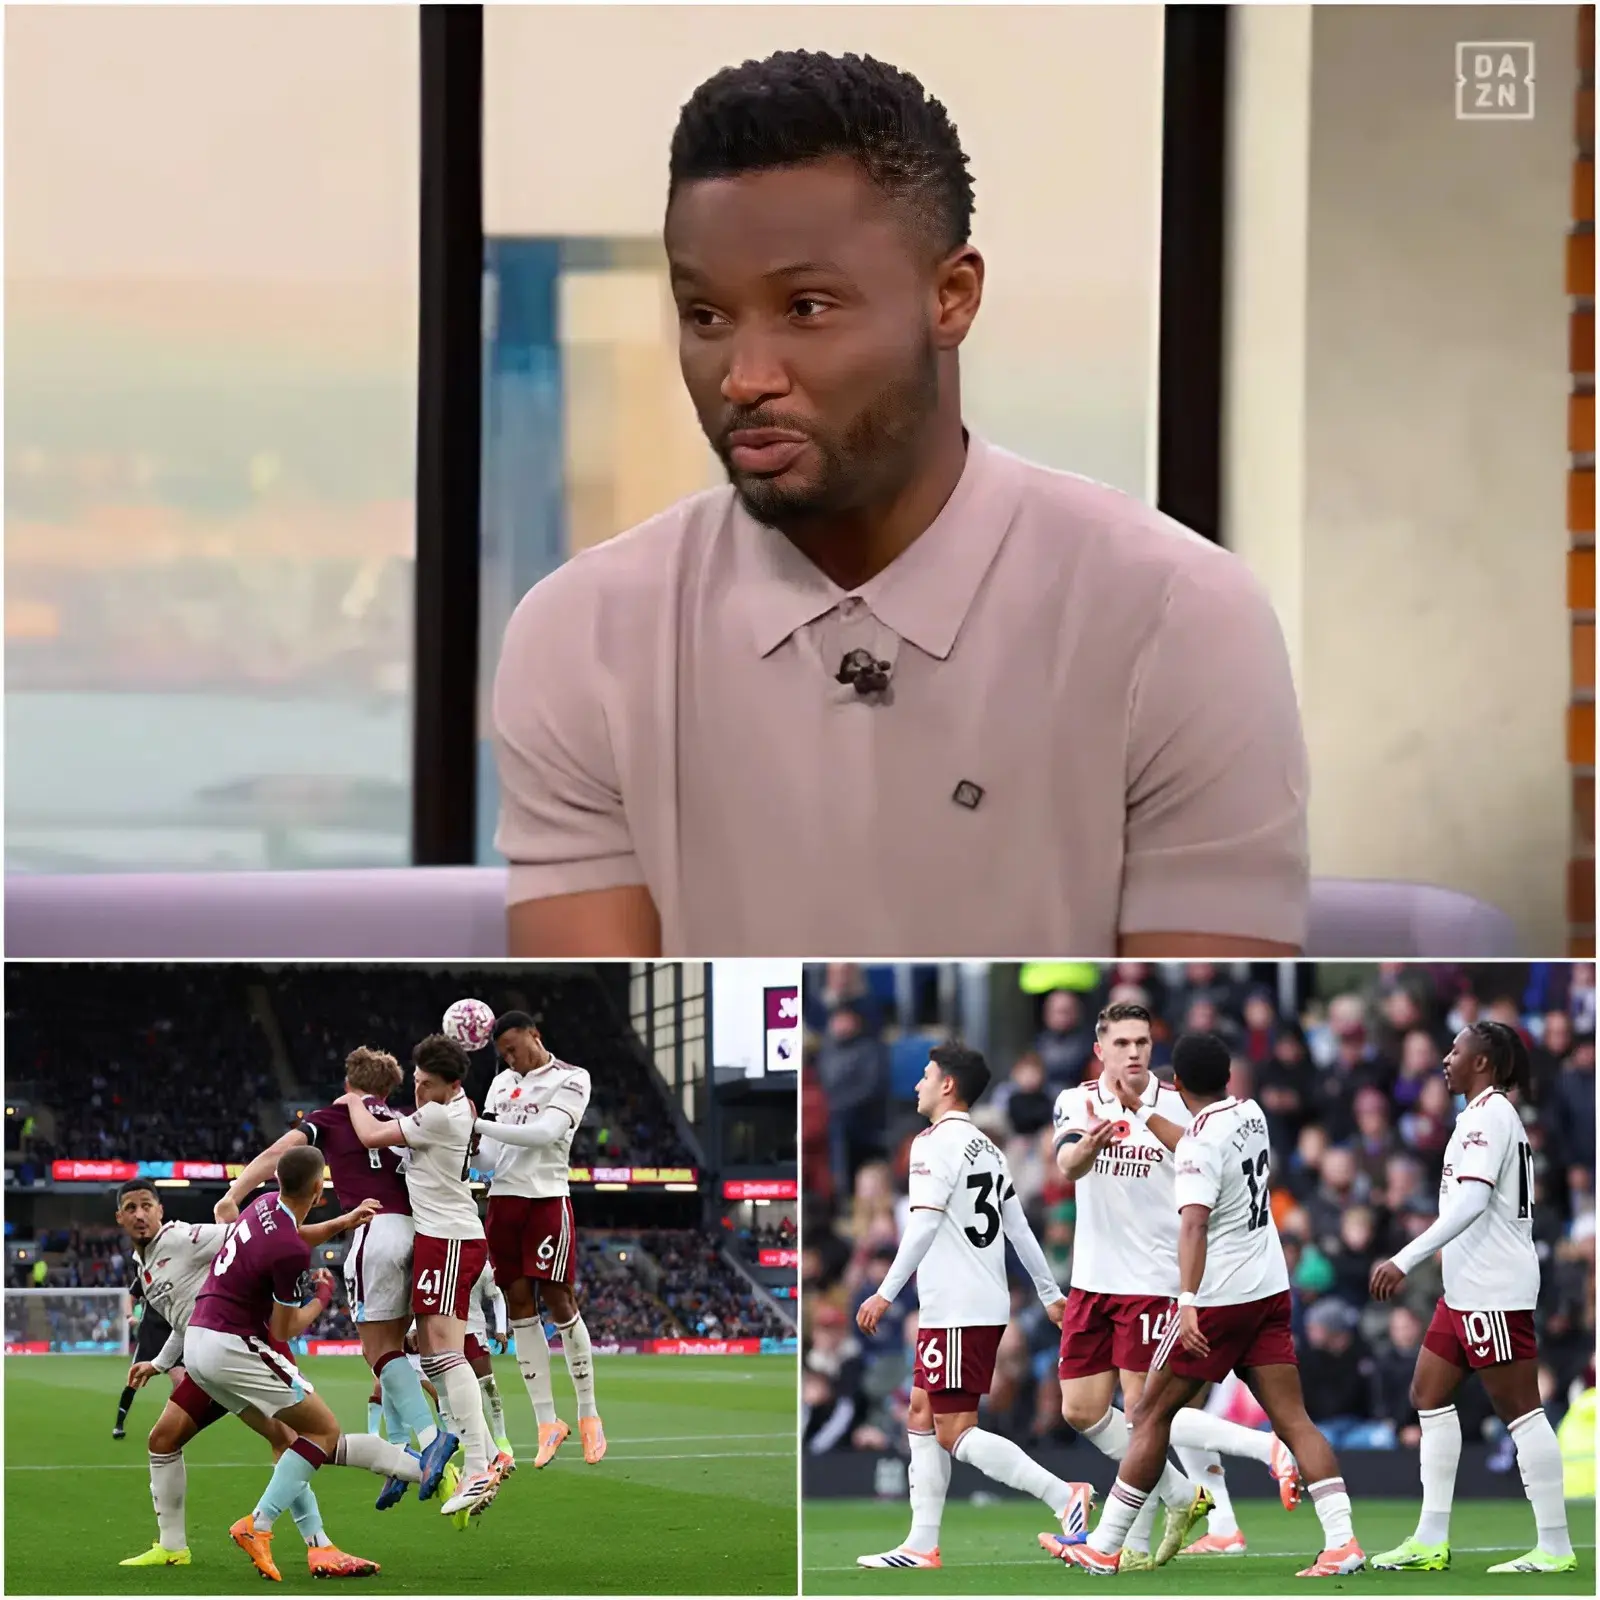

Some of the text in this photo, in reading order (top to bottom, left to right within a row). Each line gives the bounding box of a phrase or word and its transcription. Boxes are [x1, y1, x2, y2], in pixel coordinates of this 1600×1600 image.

[1241, 1148, 1269, 1232] 12
[213, 1218, 252, 1277] 5
[537, 1234, 555, 1259] 6
[416, 1268, 442, 1295] 41
[1461, 1311, 1492, 1346] 10
